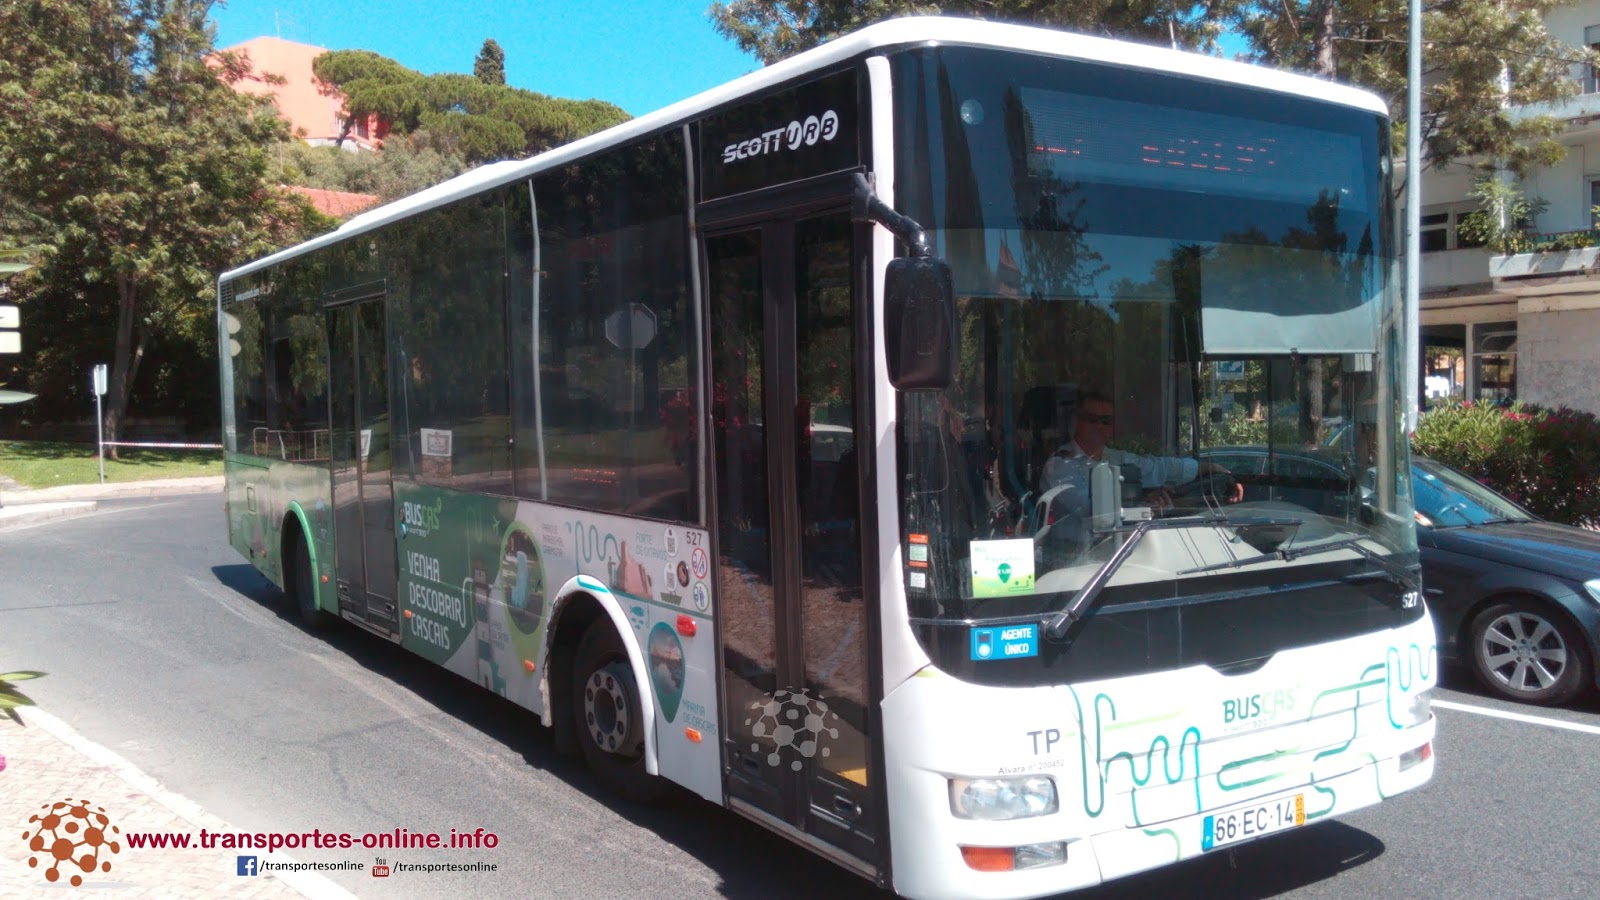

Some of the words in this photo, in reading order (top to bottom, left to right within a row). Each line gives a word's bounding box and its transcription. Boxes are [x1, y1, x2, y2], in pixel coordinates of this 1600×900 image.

[721, 110, 838, 163] SCOTTURB
[686, 531, 702, 546] 527
[407, 550, 440, 582] VENHA
[409, 581, 464, 622] DESCOBRIR
[1402, 592, 1418, 608] 527
[411, 613, 450, 650] CASCAIS
[1001, 628, 1032, 640] AGENTE
[1005, 642, 1029, 655] ÚNICO
[1027, 728, 1060, 755] TP
